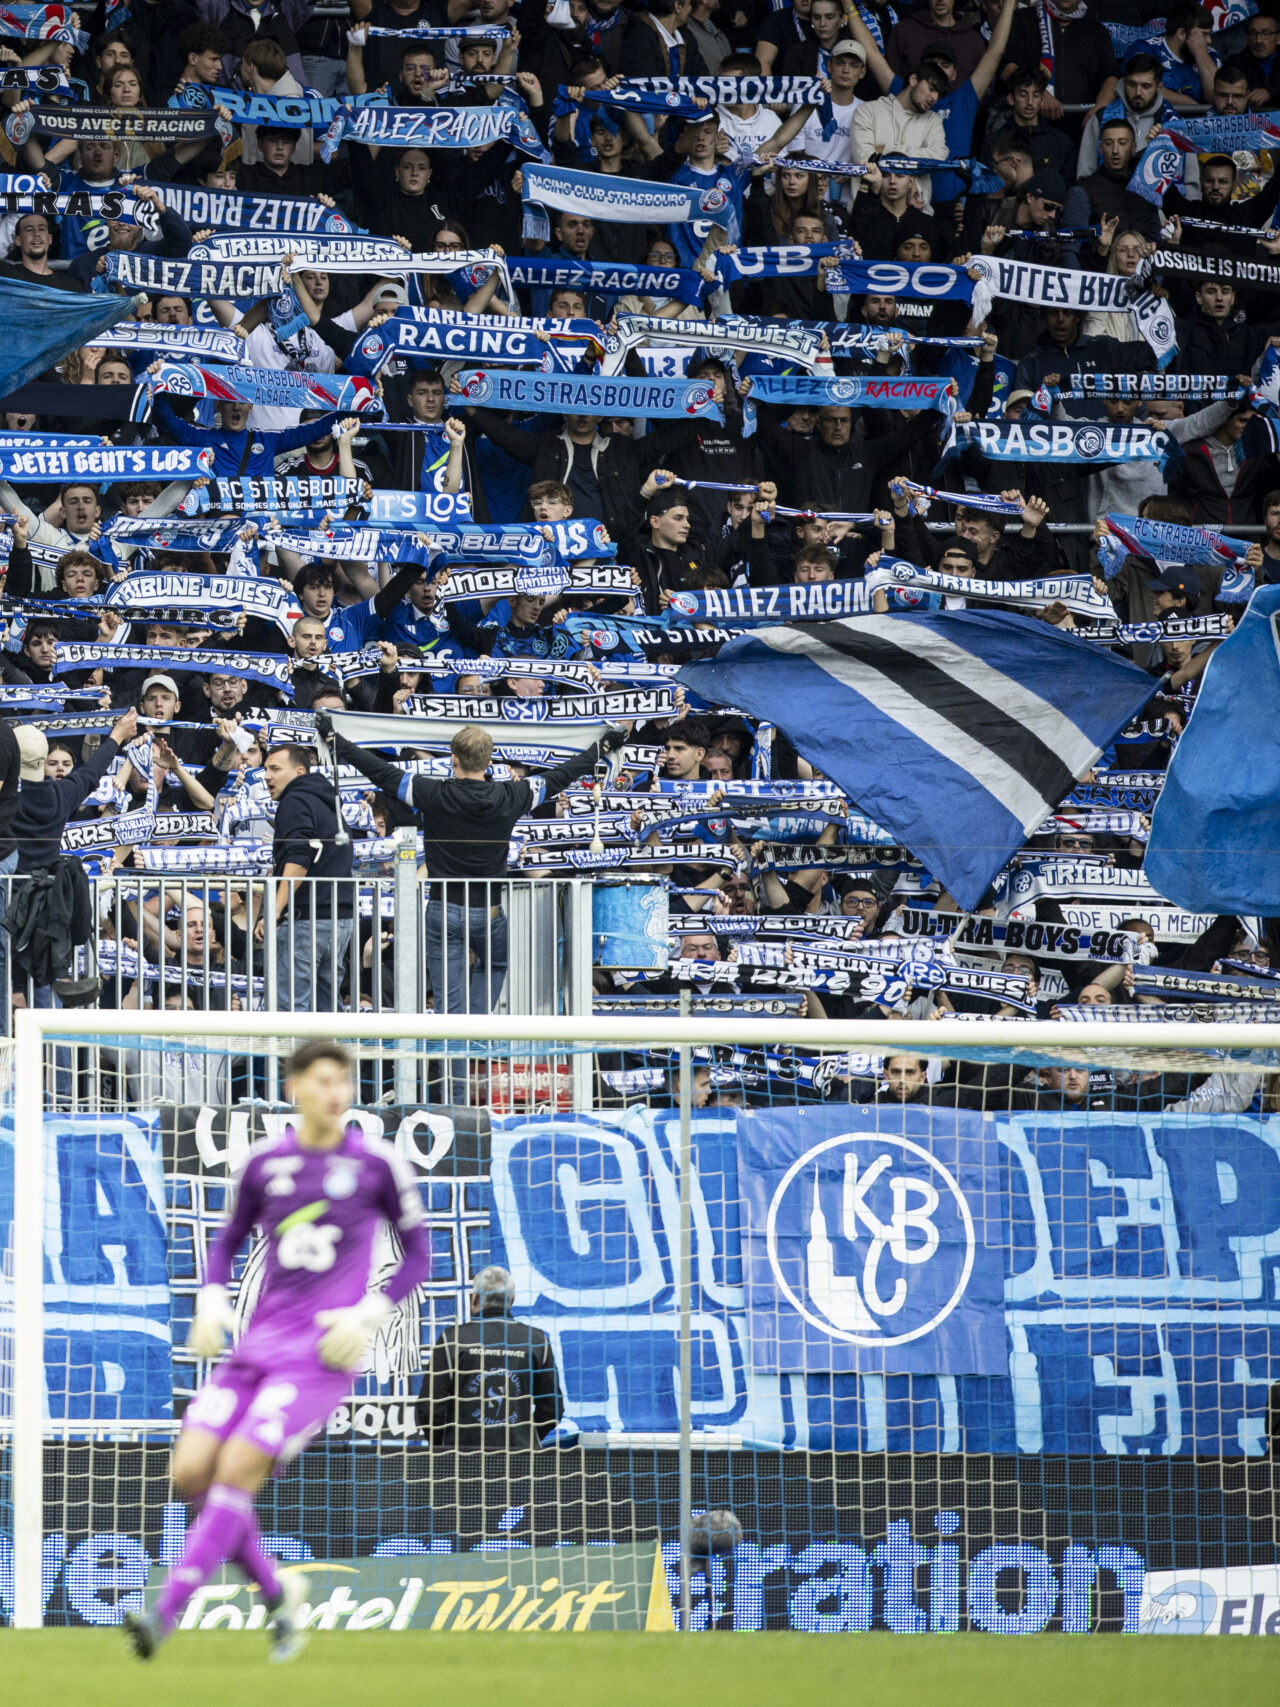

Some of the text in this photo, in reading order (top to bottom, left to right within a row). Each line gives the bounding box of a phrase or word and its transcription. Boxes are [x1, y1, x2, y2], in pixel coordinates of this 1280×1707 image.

[39, 115, 206, 133] TOUS AVEC LE RACING
[352, 109, 519, 145] ALLEZ RACING
[606, 187, 688, 207] STRASBOURG
[118, 254, 193, 294] ALLEZ
[730, 244, 815, 277] UB
[1218, 259, 1233, 277] IS
[511, 266, 681, 292] ALLEZ RACING
[867, 262, 958, 296] 90
[397, 323, 528, 356] RACING
[245, 367, 317, 391] STRASBOURG
[864, 381, 942, 404] RACING
[1069, 373, 1229, 392] RC STRASBOURG
[499, 379, 677, 411] RC STRASBOURG
[10, 449, 194, 475] JETZT GEHT'S LOS
[219, 478, 244, 498] RC
[425, 492, 473, 522] LOS
[210, 581, 289, 607] OUEST
[927, 570, 1034, 599] TRIBUNE
[704, 587, 781, 619] ALLEZ
[1004, 921, 1081, 956] BOYS
[427, 1576, 626, 1630] Twist
